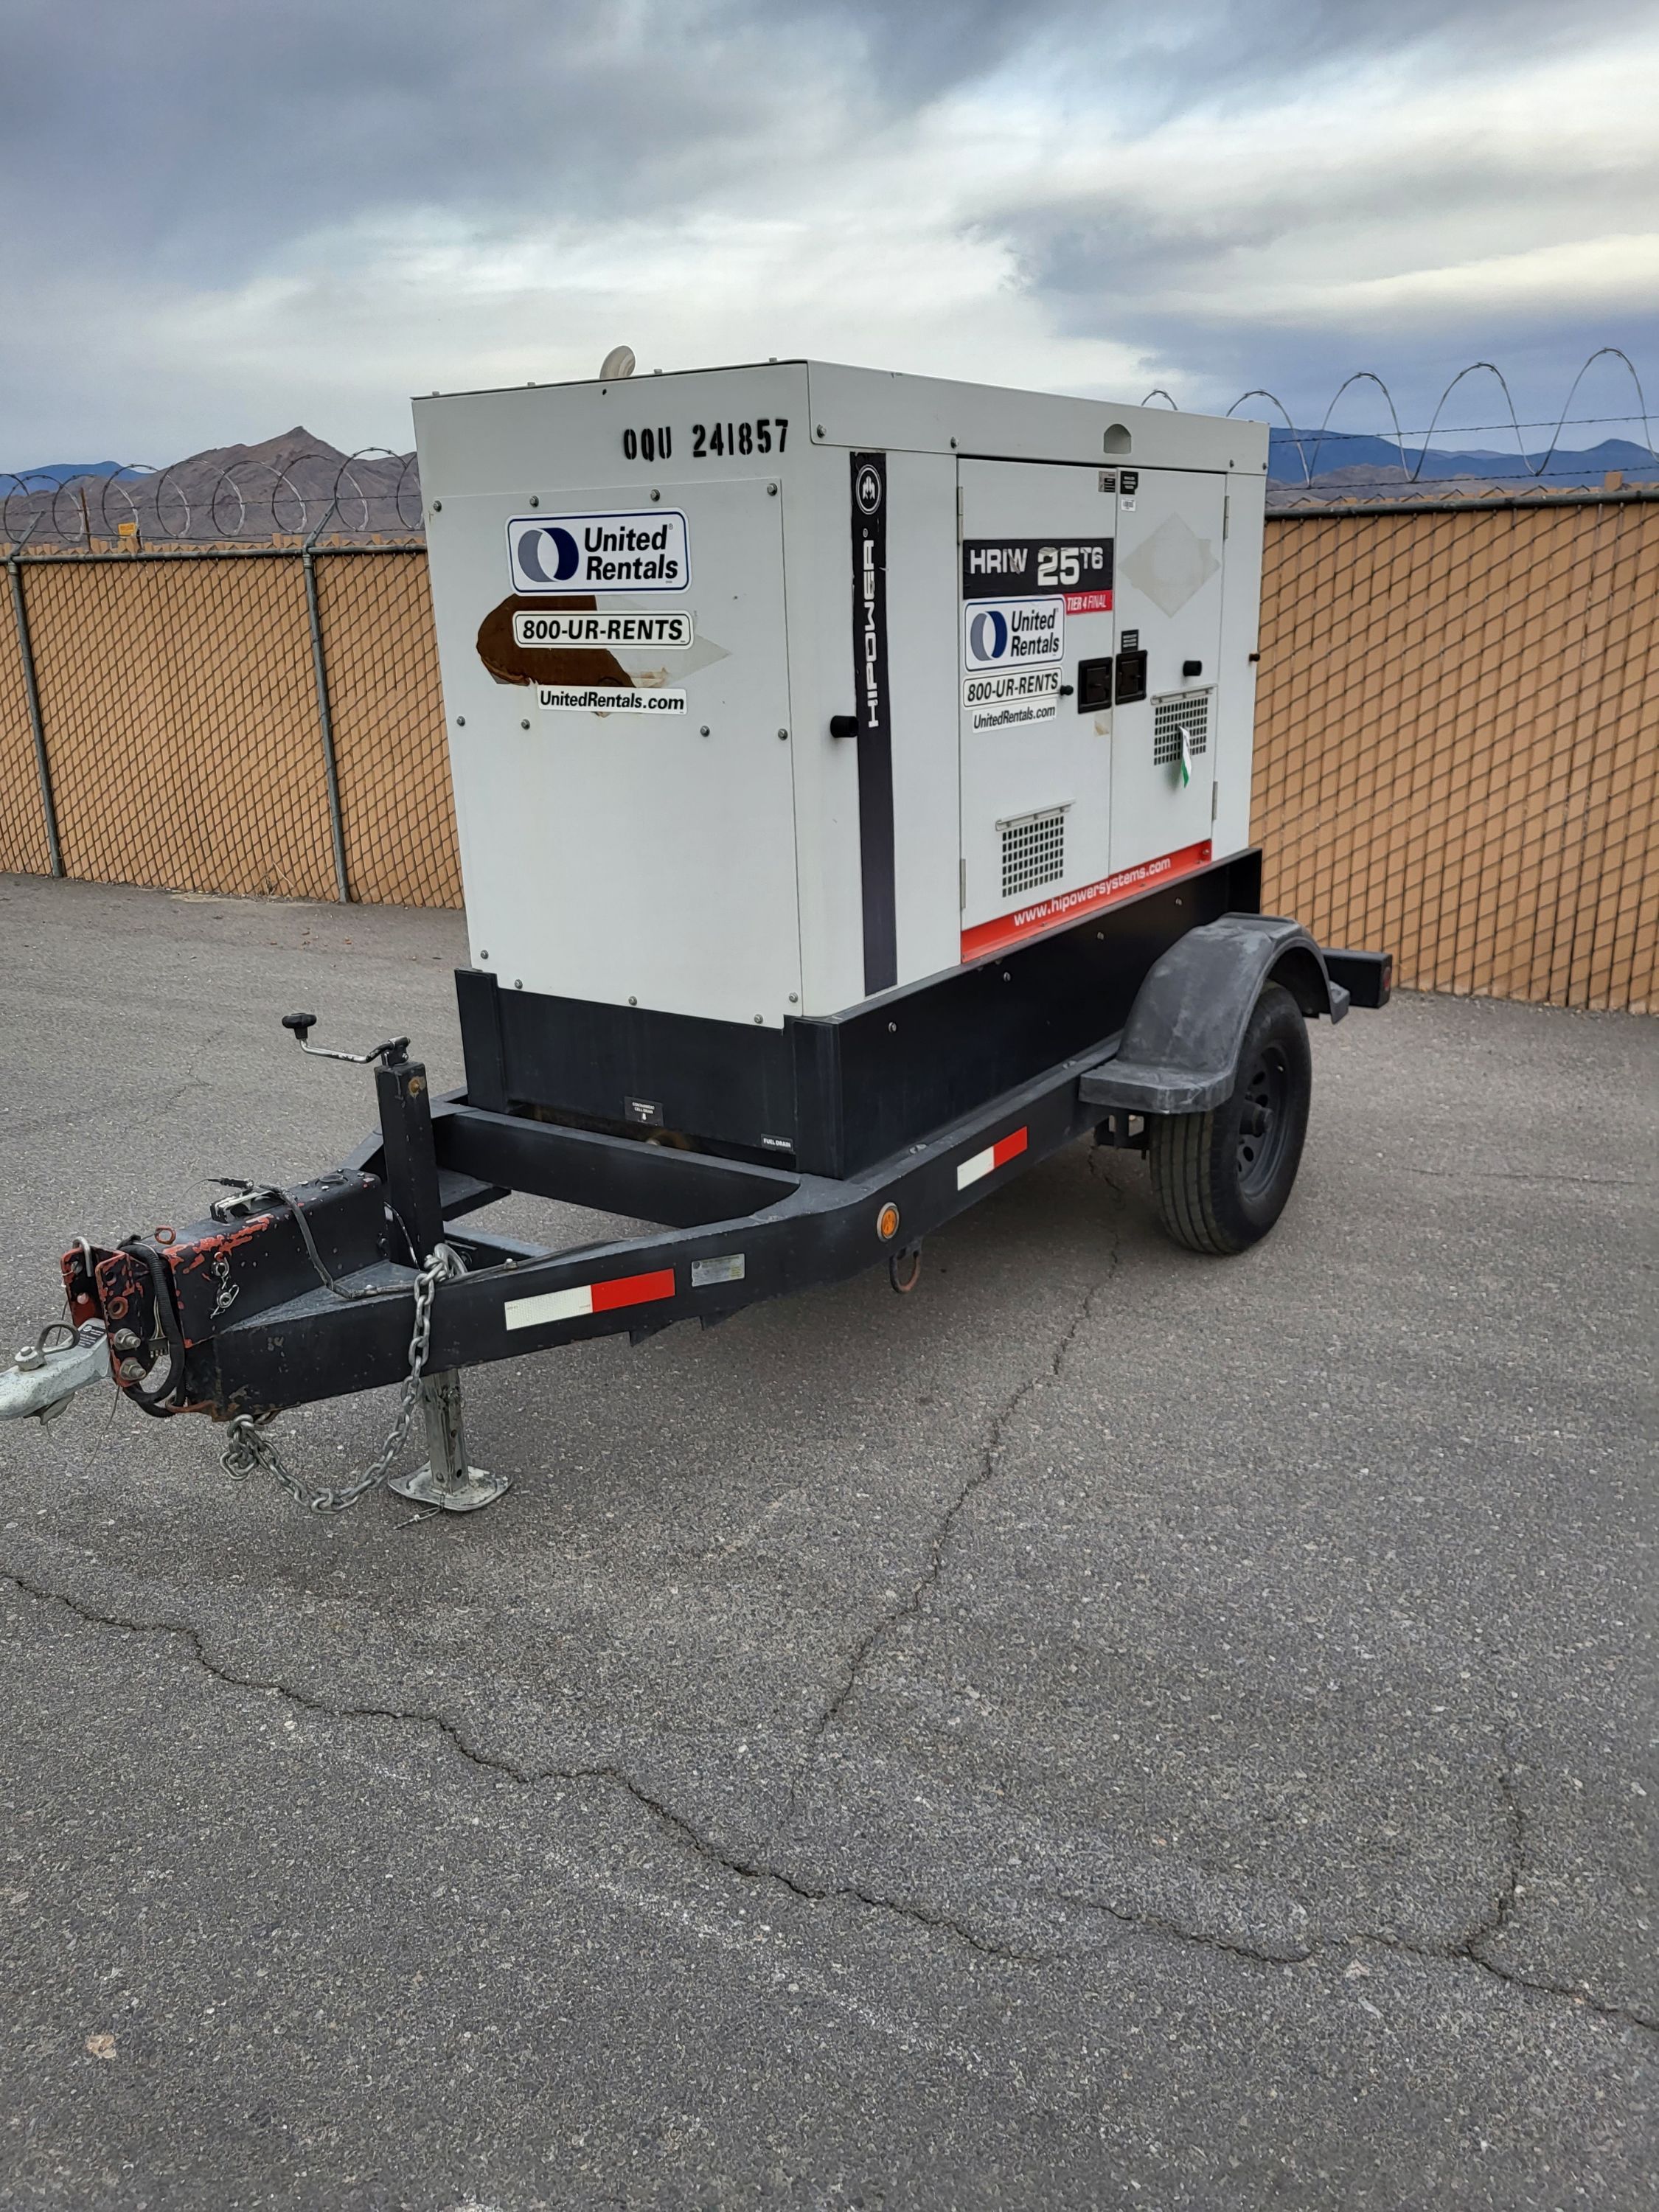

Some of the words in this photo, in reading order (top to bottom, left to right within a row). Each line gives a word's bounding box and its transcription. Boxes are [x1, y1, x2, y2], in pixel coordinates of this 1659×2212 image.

[692, 419, 788, 458] 241857
[584, 524, 668, 552] United
[586, 554, 678, 580] Rentals
[1067, 597, 1082, 611] TIER
[1082, 595, 1088, 610] 4
[1088, 594, 1107, 609] FINAL
[523, 619, 683, 641] 800-UR-RENTS
[1011, 608, 1057, 633] United
[856, 540, 879, 728] HIPOWER
[1010, 632, 1060, 657] Rentals
[540, 690, 684, 710] UnitedRentals.com
[967, 672, 1059, 703] 800-UR-RENTS
[973, 706, 1056, 729] UnitedRentals.com
[1014, 857, 1172, 927] www.hipowersystems.com
[775, 1139, 791, 1148] DRAIN
